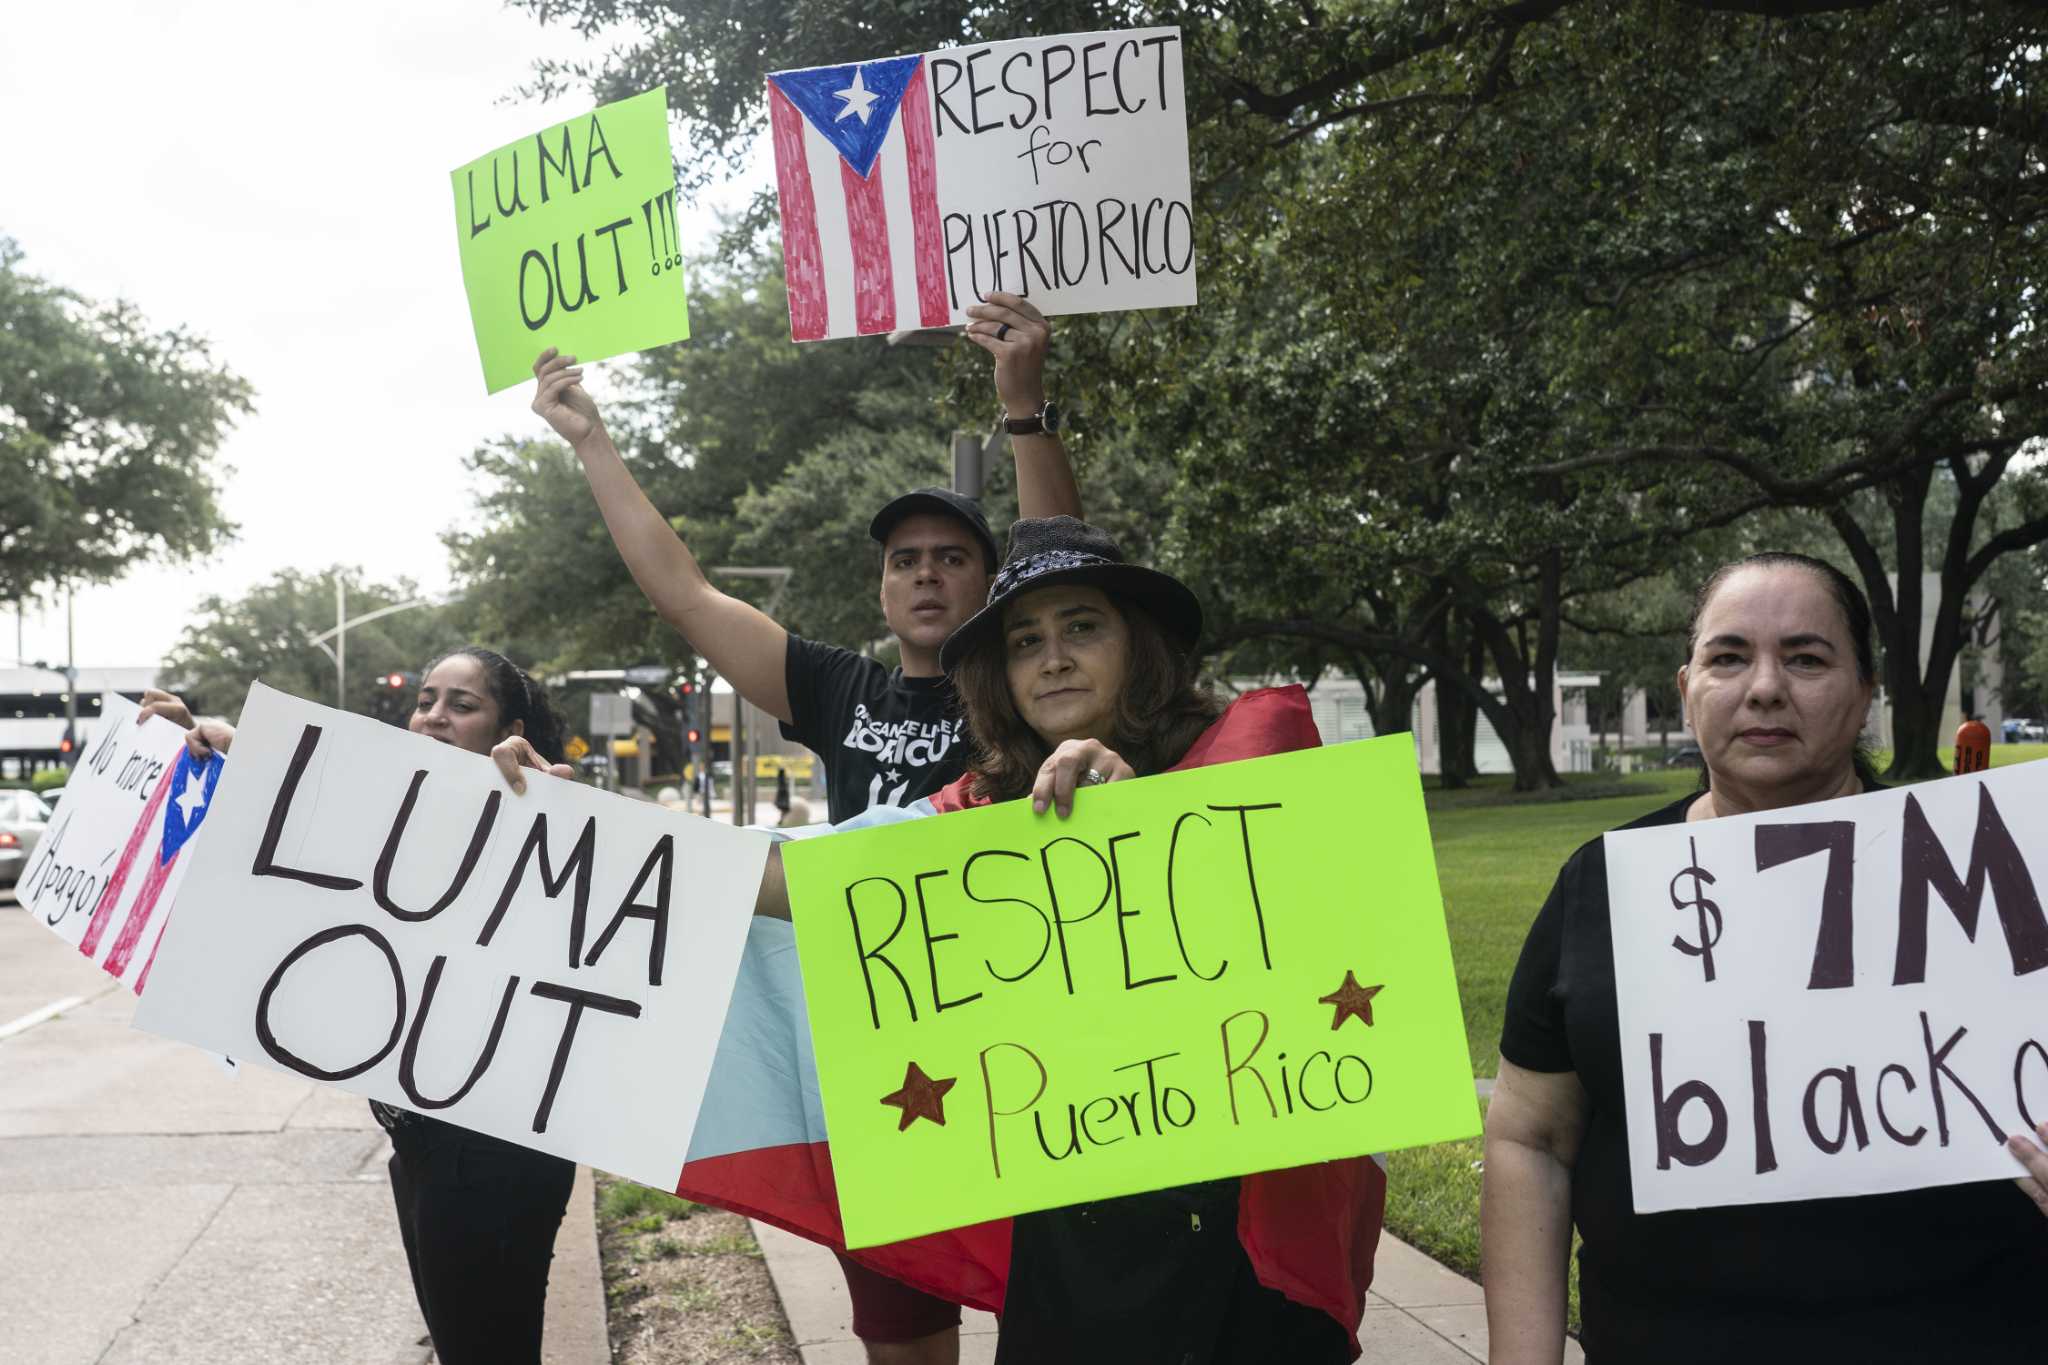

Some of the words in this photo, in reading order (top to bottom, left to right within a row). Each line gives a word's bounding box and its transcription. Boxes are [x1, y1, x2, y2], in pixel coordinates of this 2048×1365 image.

[930, 35, 1179, 137] RESPECT
[468, 114, 623, 239] LUMA
[1017, 125, 1102, 184] for
[519, 190, 682, 331] OUT!!!
[944, 200, 1089, 309] PUERTO
[1096, 198, 1194, 285] RICO
[89, 717, 124, 775] No
[116, 750, 163, 800] more
[252, 725, 673, 986] LUMA
[845, 804, 1282, 1029] RESPECT
[255, 924, 641, 1133] OUT
[1221, 1010, 1373, 1125] Rico
